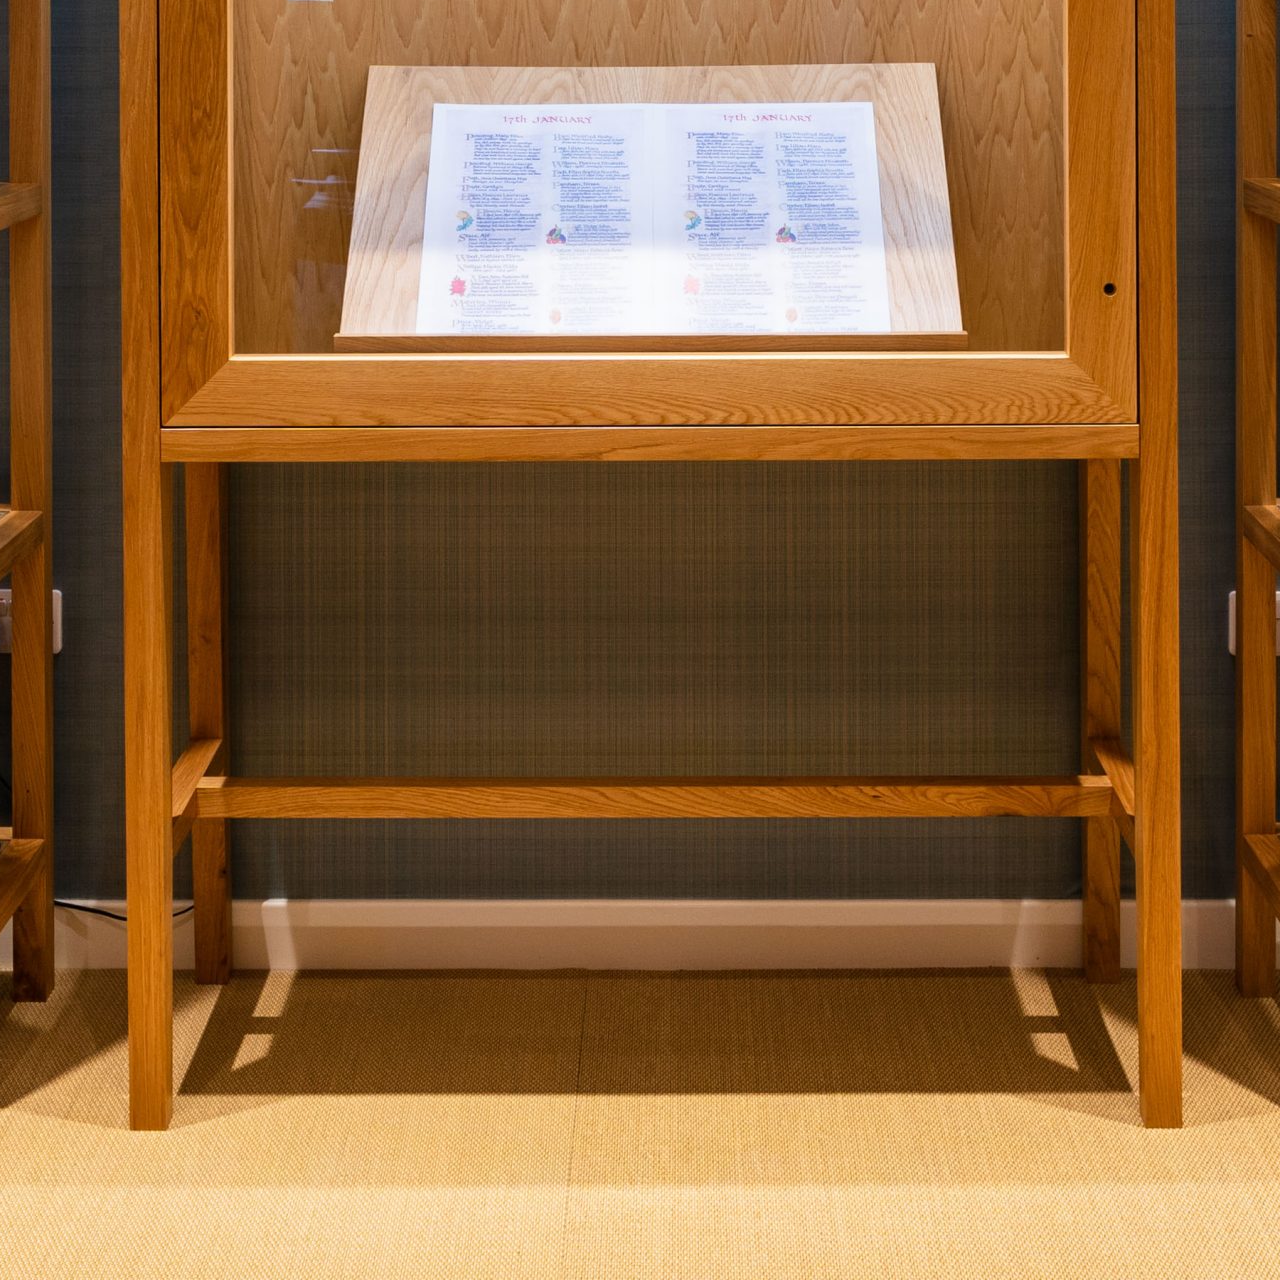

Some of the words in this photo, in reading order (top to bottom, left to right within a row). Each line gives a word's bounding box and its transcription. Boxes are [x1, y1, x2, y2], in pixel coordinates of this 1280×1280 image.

[503, 114, 527, 125] 17th
[531, 115, 592, 125] JANUARY
[723, 113, 747, 123] 17th
[752, 113, 813, 123] JANUARY
